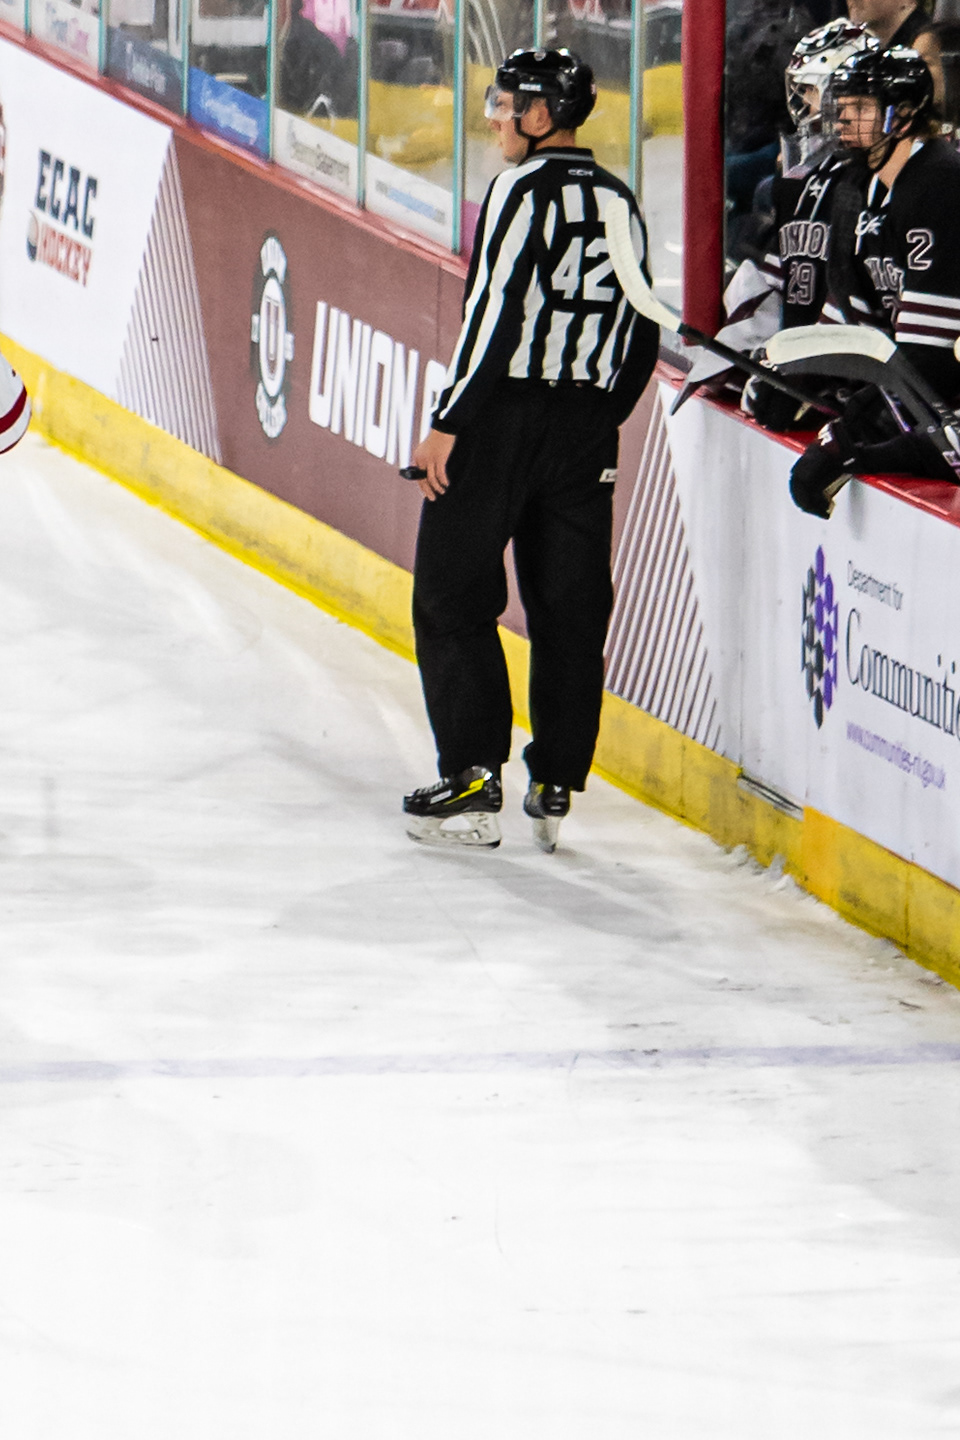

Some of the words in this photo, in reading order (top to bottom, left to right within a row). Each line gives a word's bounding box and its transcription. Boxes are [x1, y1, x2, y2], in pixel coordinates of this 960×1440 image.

[34, 147, 98, 241] ECAC
[39, 221, 93, 288] HOCKEY
[550, 236, 617, 303] 42
[906, 228, 935, 271] 2
[786, 261, 817, 306] 29
[309, 299, 421, 469] UNION
